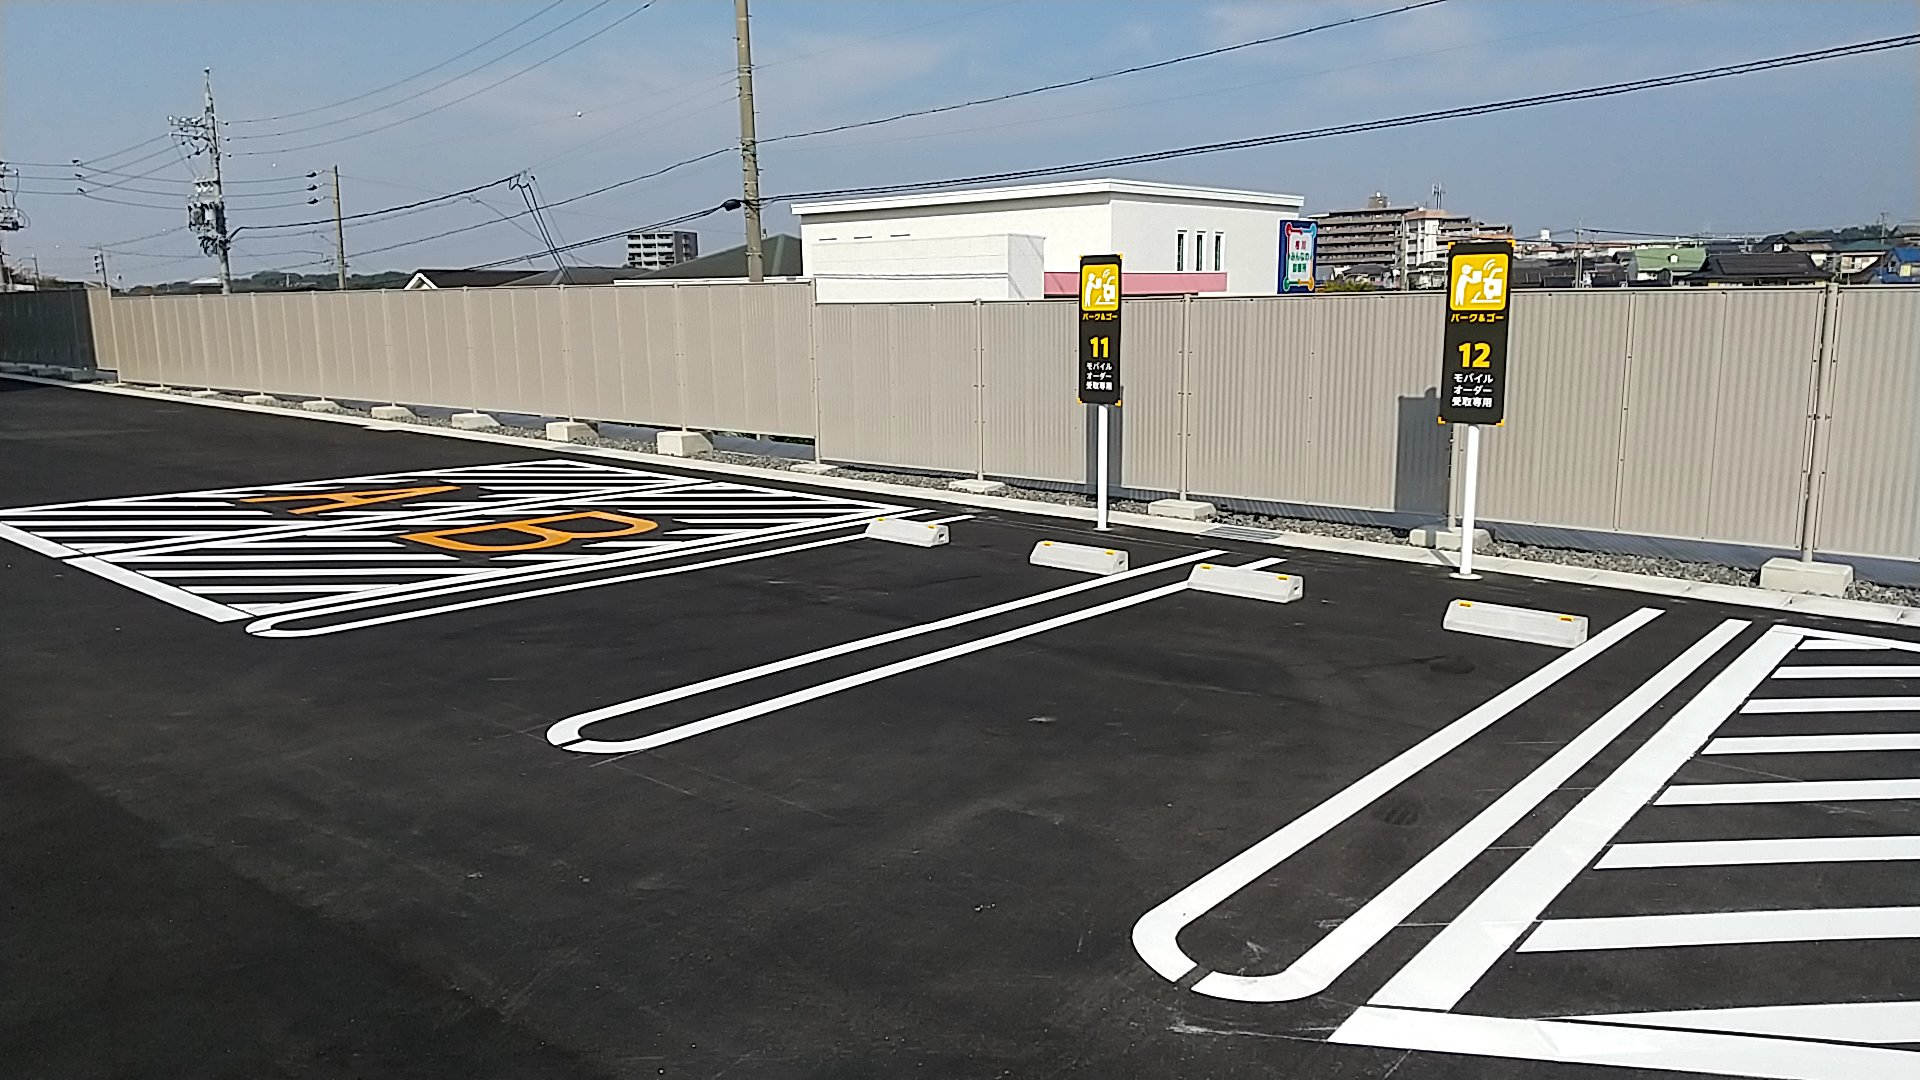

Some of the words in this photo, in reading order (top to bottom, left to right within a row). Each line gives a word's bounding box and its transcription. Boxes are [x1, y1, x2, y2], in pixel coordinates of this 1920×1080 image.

[1451, 313, 1504, 322] パーク&ゴー
[1090, 337, 1109, 358] 11
[1458, 342, 1491, 368] 12
[1086, 362, 1112, 370] モバイル
[1086, 372, 1112, 380] オーダー
[1453, 373, 1494, 383] モバイル
[1453, 385, 1493, 395] オーダー
[1451, 397, 1493, 408] 受取専用
[239, 485, 462, 514] A
[399, 510, 659, 552] B
